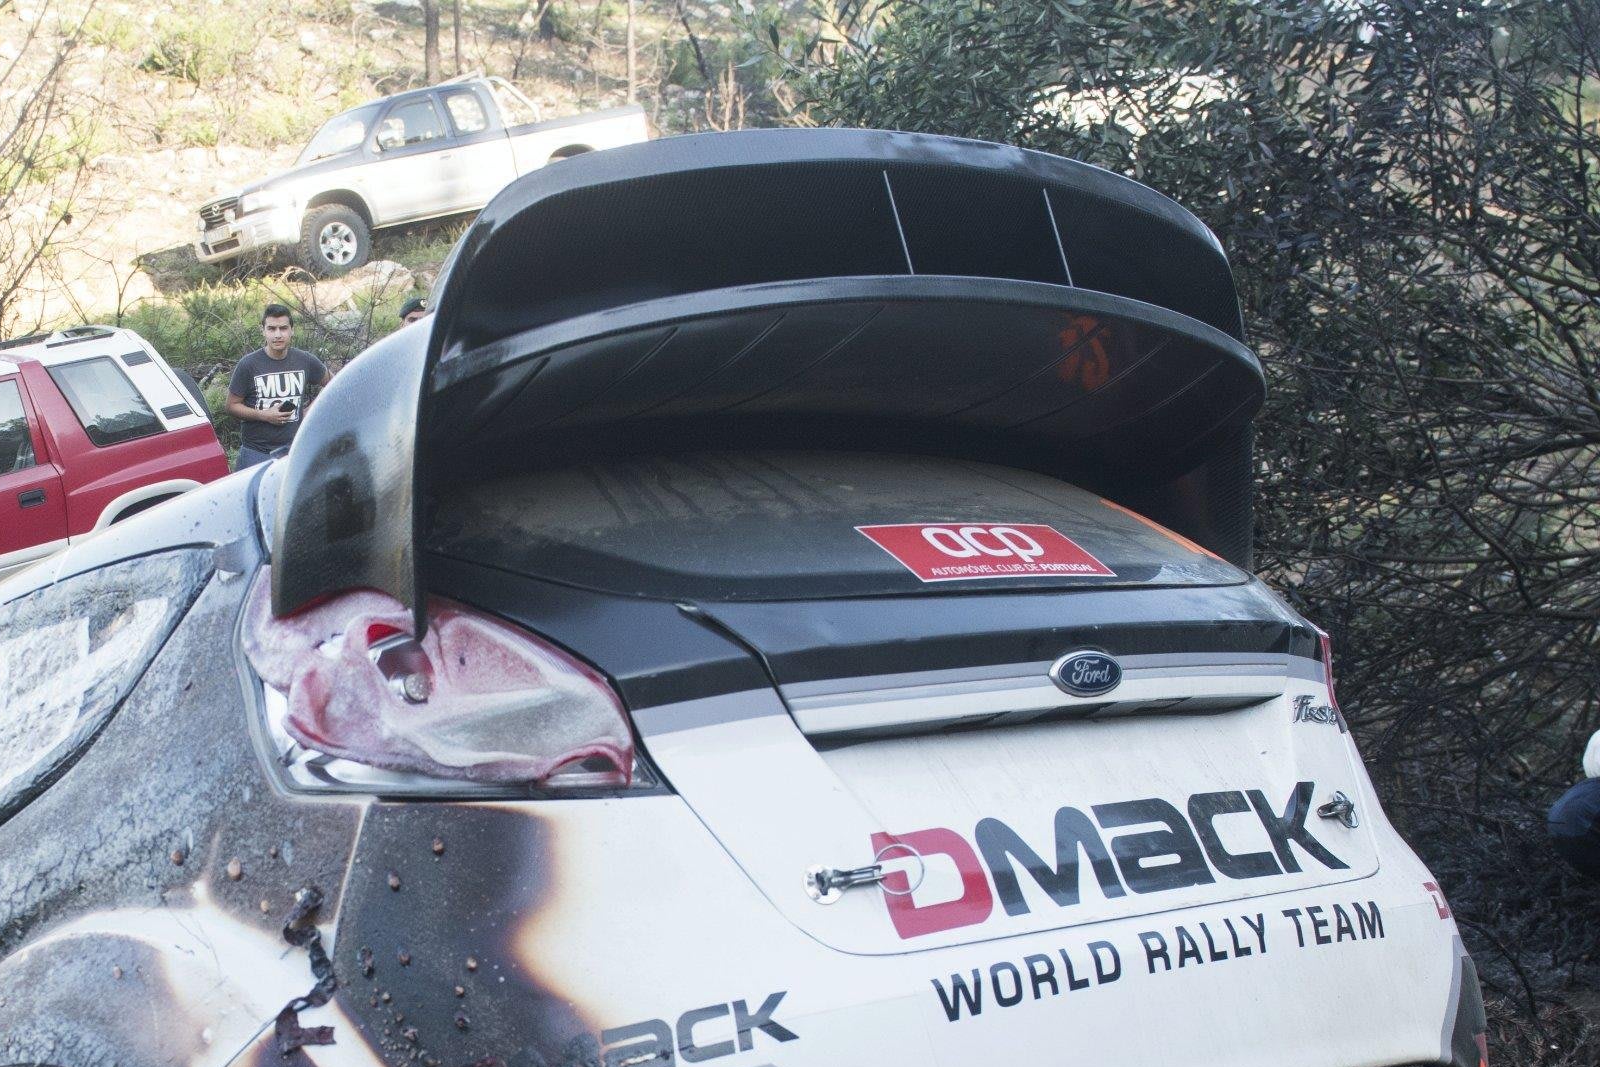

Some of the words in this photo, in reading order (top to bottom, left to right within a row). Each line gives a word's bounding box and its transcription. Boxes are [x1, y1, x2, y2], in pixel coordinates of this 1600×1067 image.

[256, 372, 304, 398] MUN
[920, 526, 1046, 563] acp
[931, 563, 997, 576] AUTOMÓVEL
[997, 563, 1026, 574] CLUB
[1026, 563, 1041, 572] DE
[1042, 562, 1097, 572] PORTUGAL
[1071, 657, 1111, 685] Ford
[931, 941, 1123, 1023] WORLD
[1138, 914, 1269, 975] RALLY
[1282, 901, 1386, 949] TEAM
